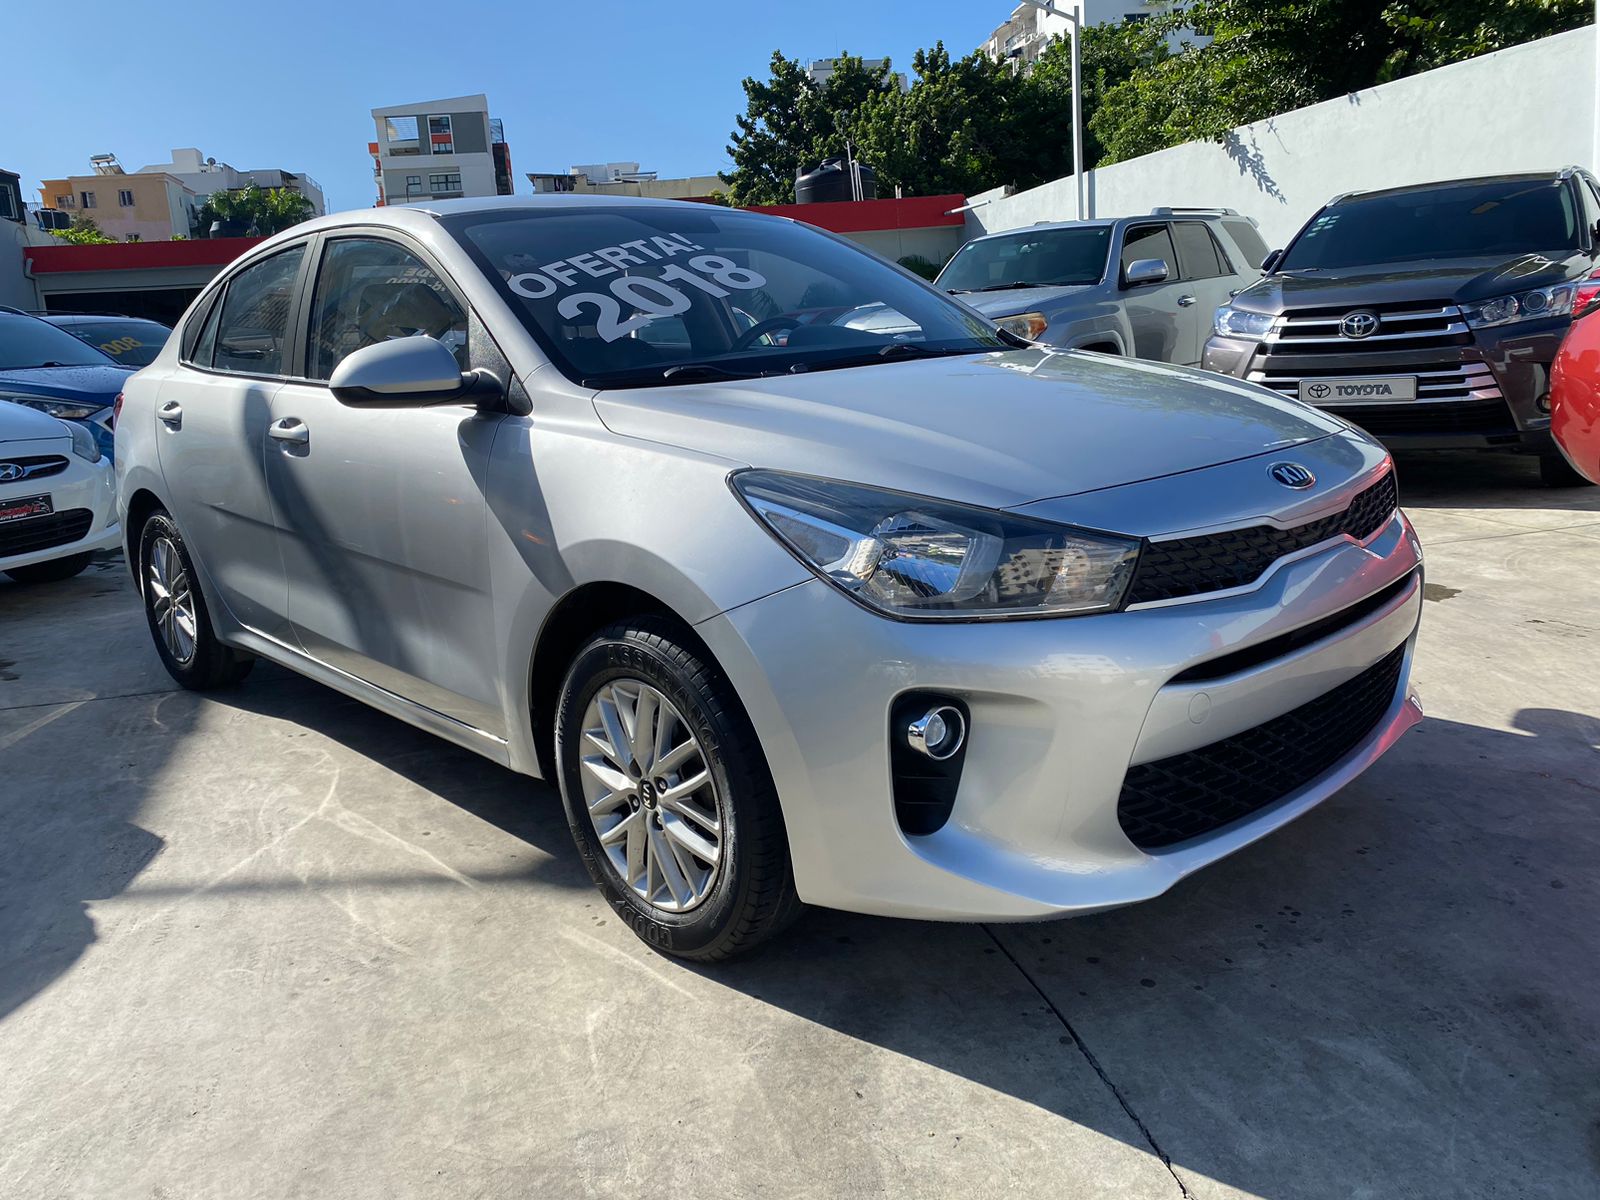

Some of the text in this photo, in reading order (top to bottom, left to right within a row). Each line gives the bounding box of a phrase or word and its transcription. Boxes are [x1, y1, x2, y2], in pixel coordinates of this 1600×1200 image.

[508, 233, 704, 299] OFERTA!
[558, 255, 767, 343] 2018
[1336, 383, 1392, 397] TOYOTA
[642, 783, 651, 808] KIA
